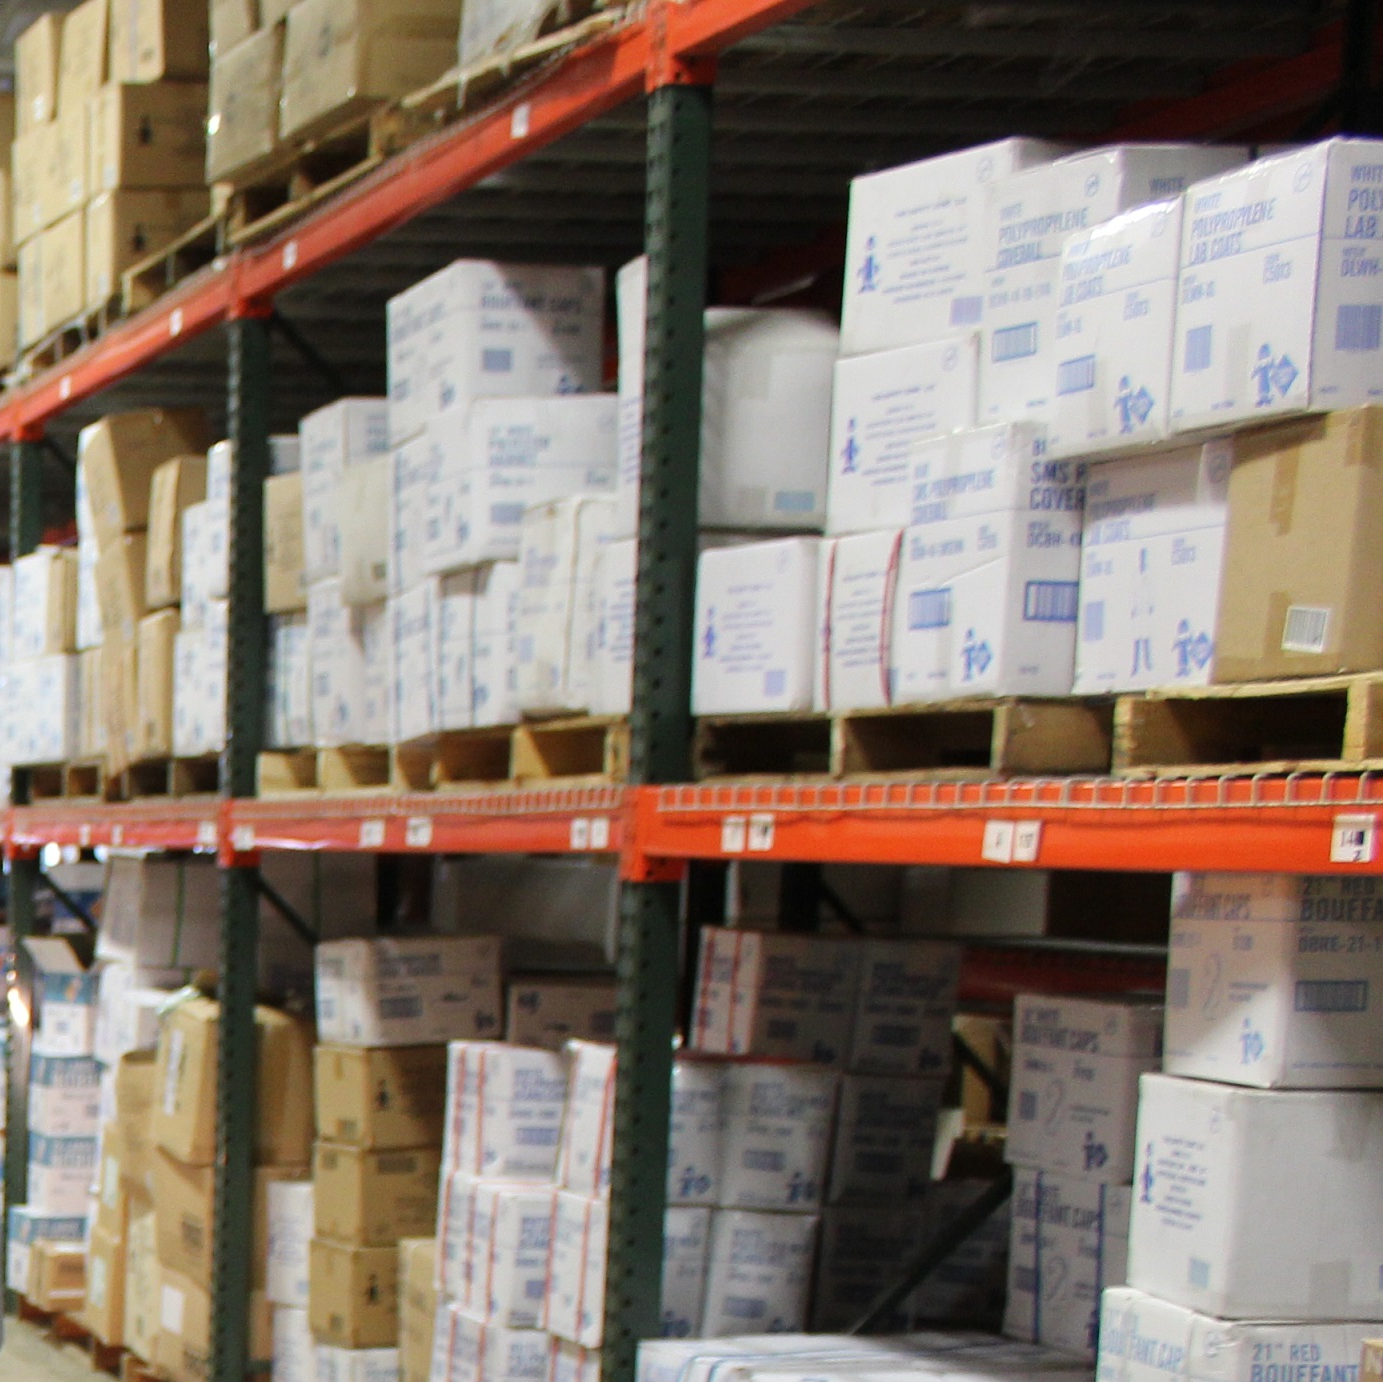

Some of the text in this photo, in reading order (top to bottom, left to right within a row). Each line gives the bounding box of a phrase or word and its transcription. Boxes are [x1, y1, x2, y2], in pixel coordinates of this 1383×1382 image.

[1345, 216, 1376, 239] LAB
[1031, 461, 1069, 484] SMS
[1252, 1343, 1321, 1361] 21" RED
